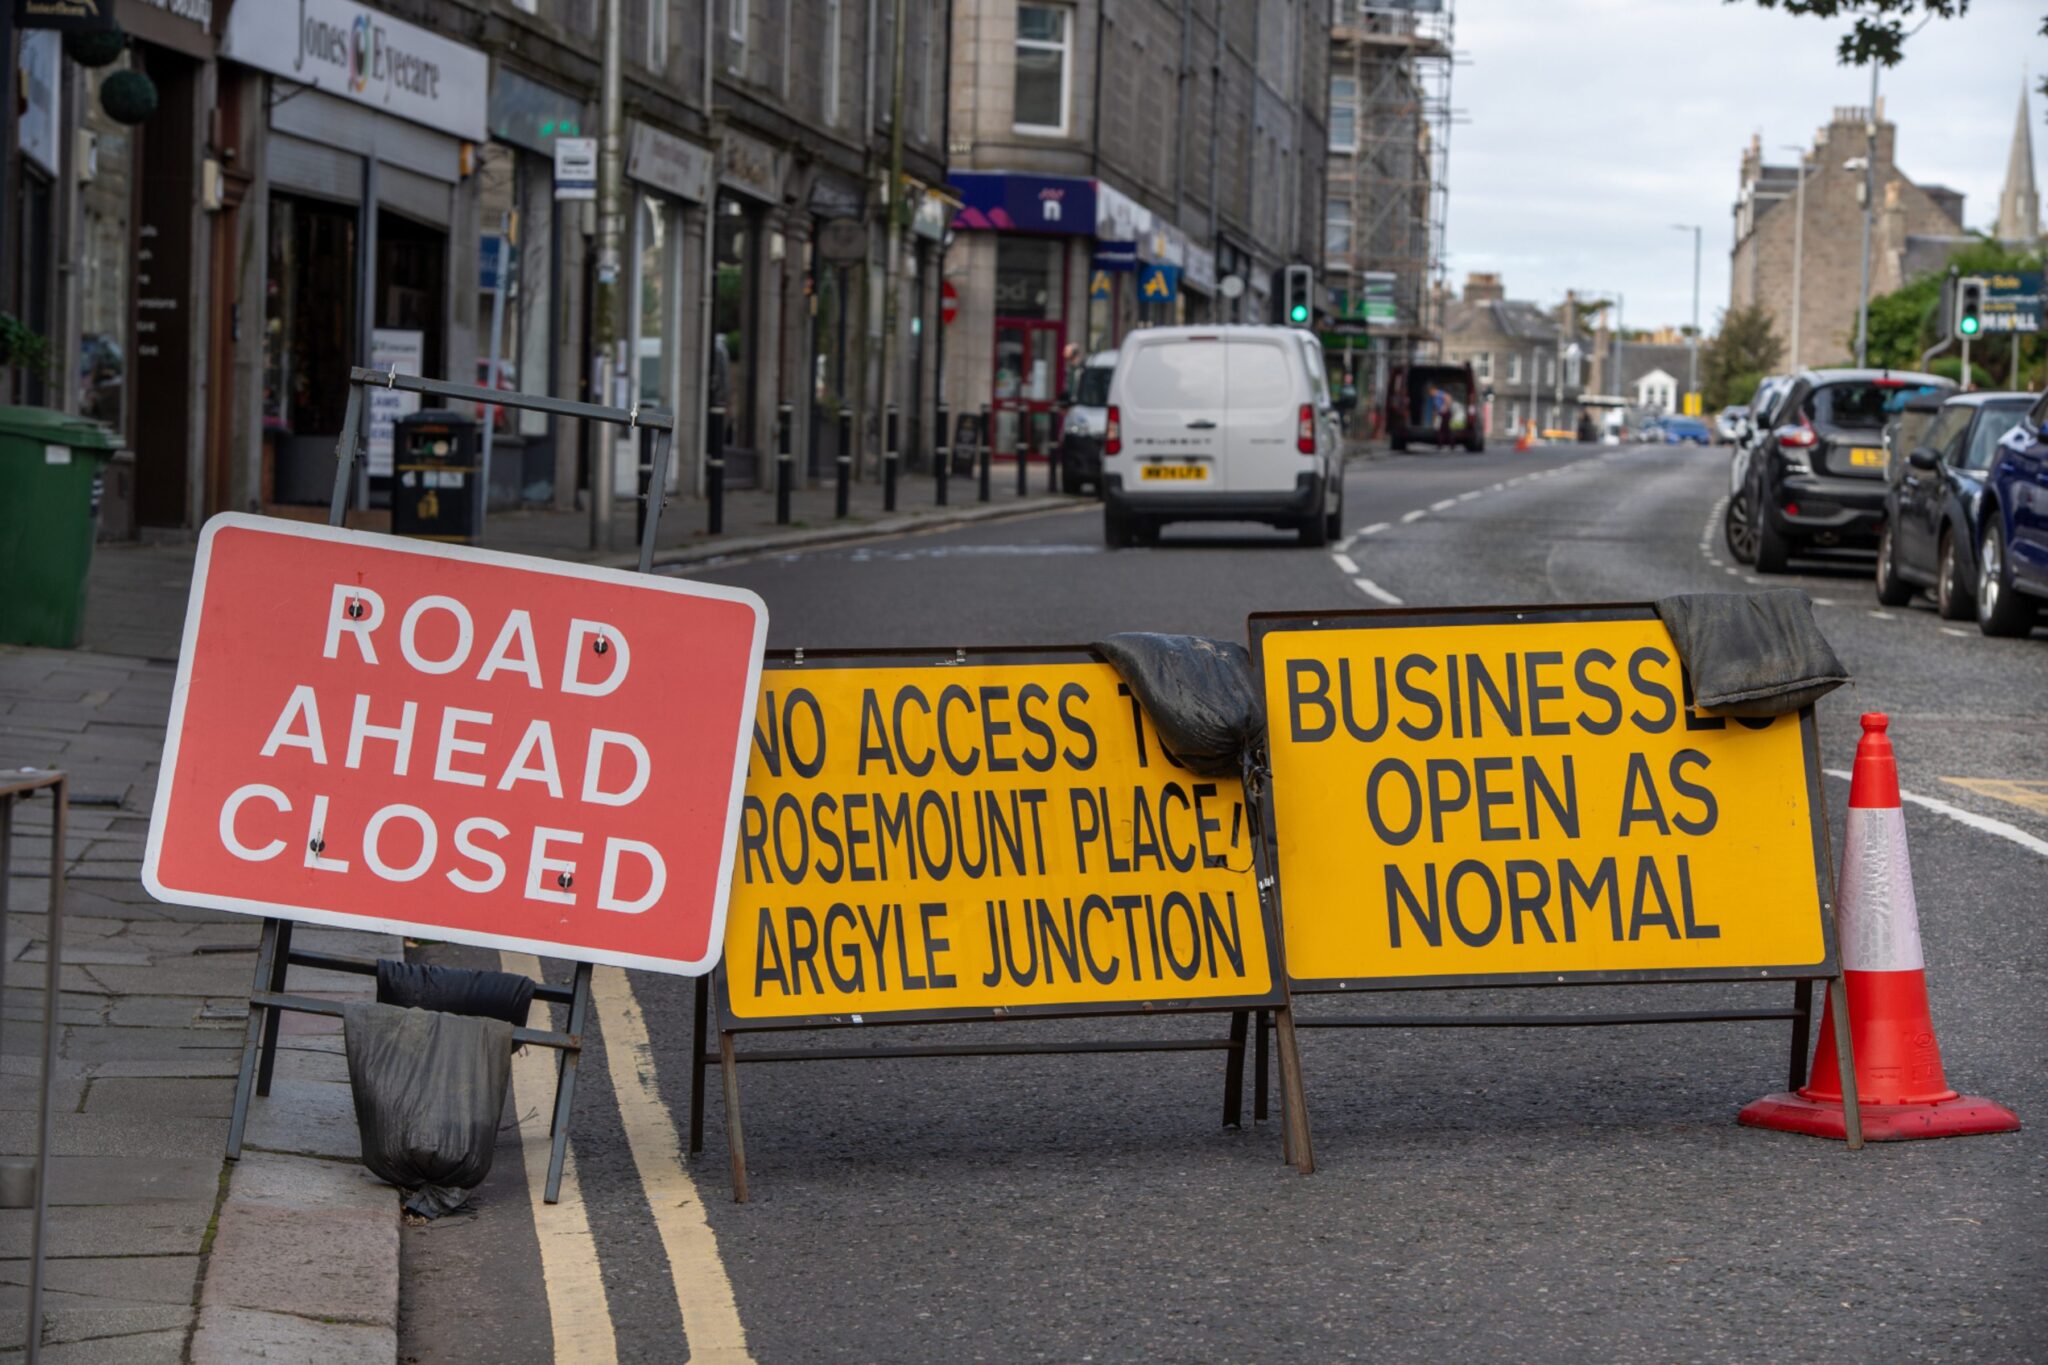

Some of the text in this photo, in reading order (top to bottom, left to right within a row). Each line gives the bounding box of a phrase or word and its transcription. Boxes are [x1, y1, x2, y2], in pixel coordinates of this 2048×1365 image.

[294, 0, 348, 71] Jones
[371, 25, 441, 104] Eyecare
[322, 583, 631, 697] ROAD
[259, 684, 652, 807] AHEAD
[748, 682, 1186, 779] NO ACCESS T
[1286, 646, 1778, 744] BUSINESS
[740, 788, 1048, 886] ROSEMOUNT
[1366, 748, 1719, 847] OPEN AS
[218, 783, 668, 915] CLOSED
[754, 890, 1246, 998] ARGYLE JUNCTION
[1383, 854, 1721, 949] NORMAL
